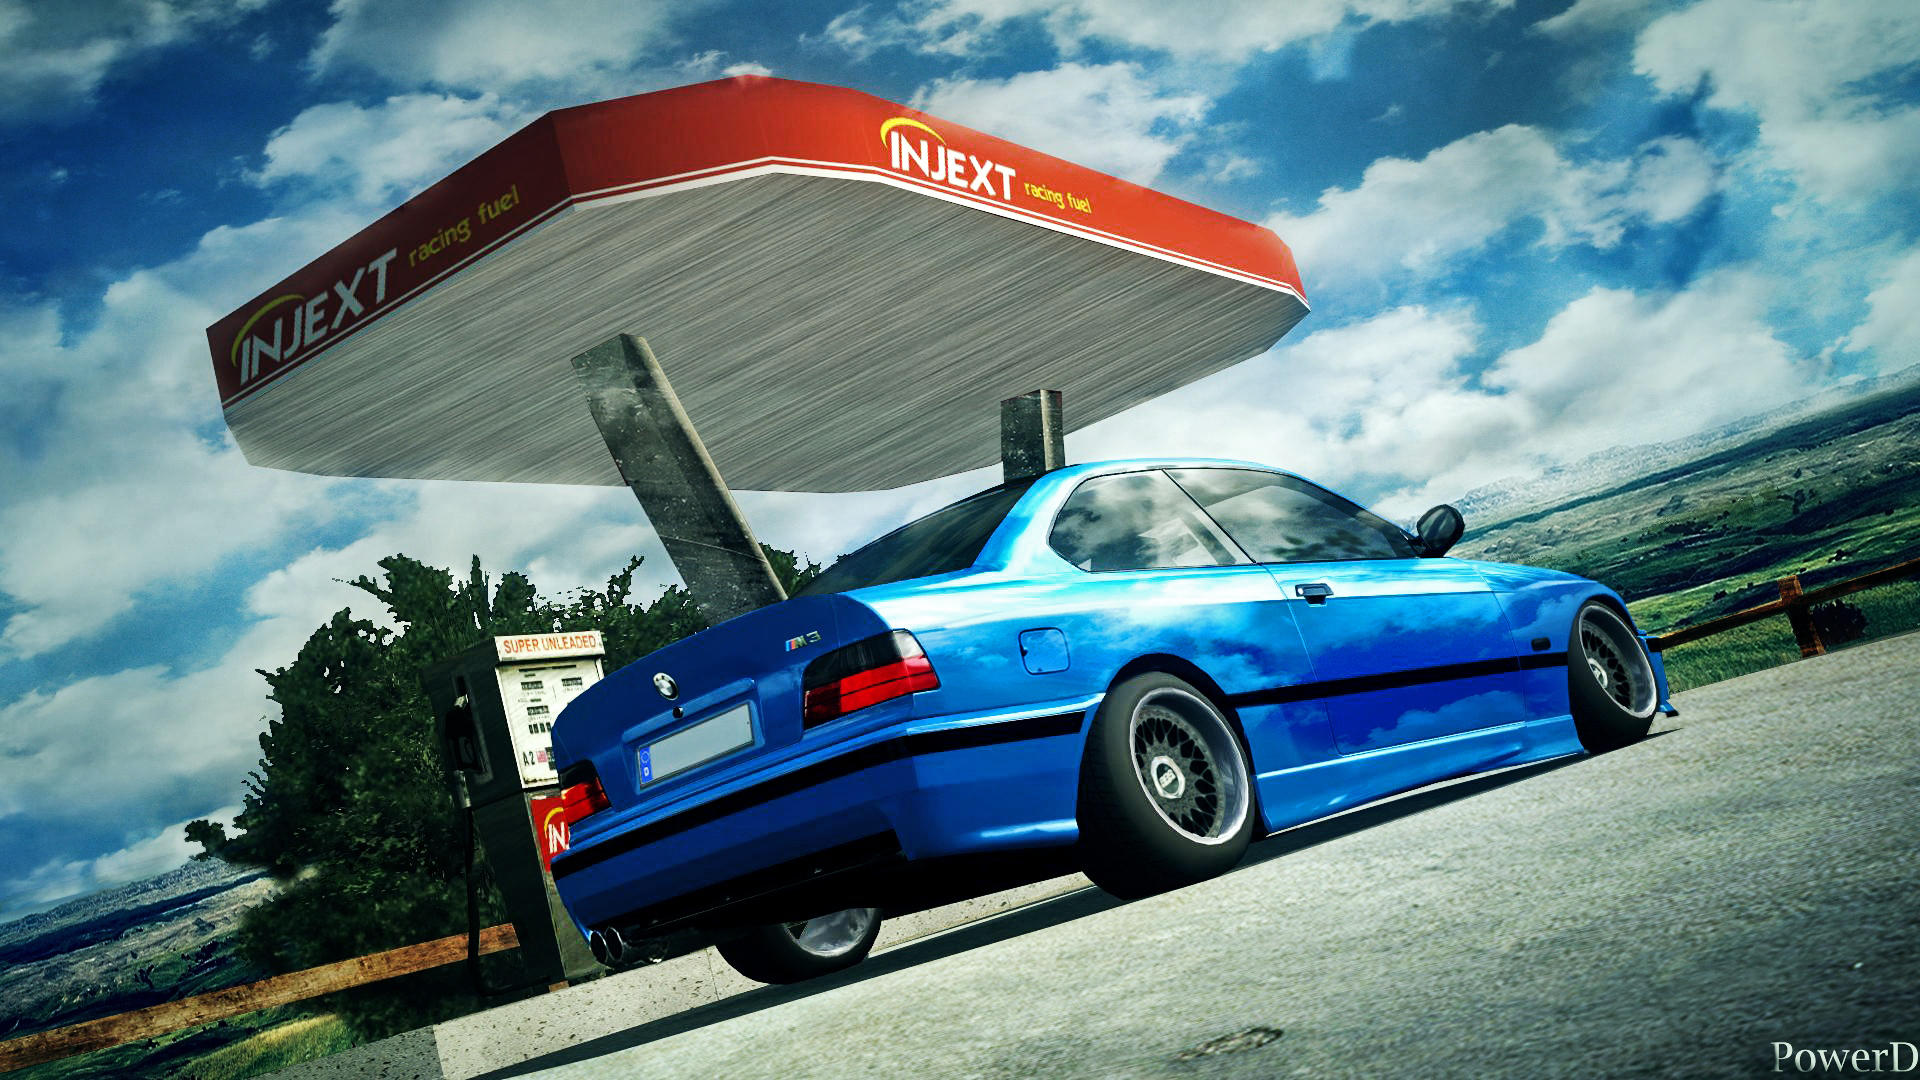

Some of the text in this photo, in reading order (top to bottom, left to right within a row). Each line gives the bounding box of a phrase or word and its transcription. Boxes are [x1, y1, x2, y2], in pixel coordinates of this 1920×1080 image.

[890, 131, 1092, 214] INJEXT racing fuel
[240, 184, 520, 386] INJEXT racing fuel
[503, 635, 597, 654] SUPER UNLEADED
